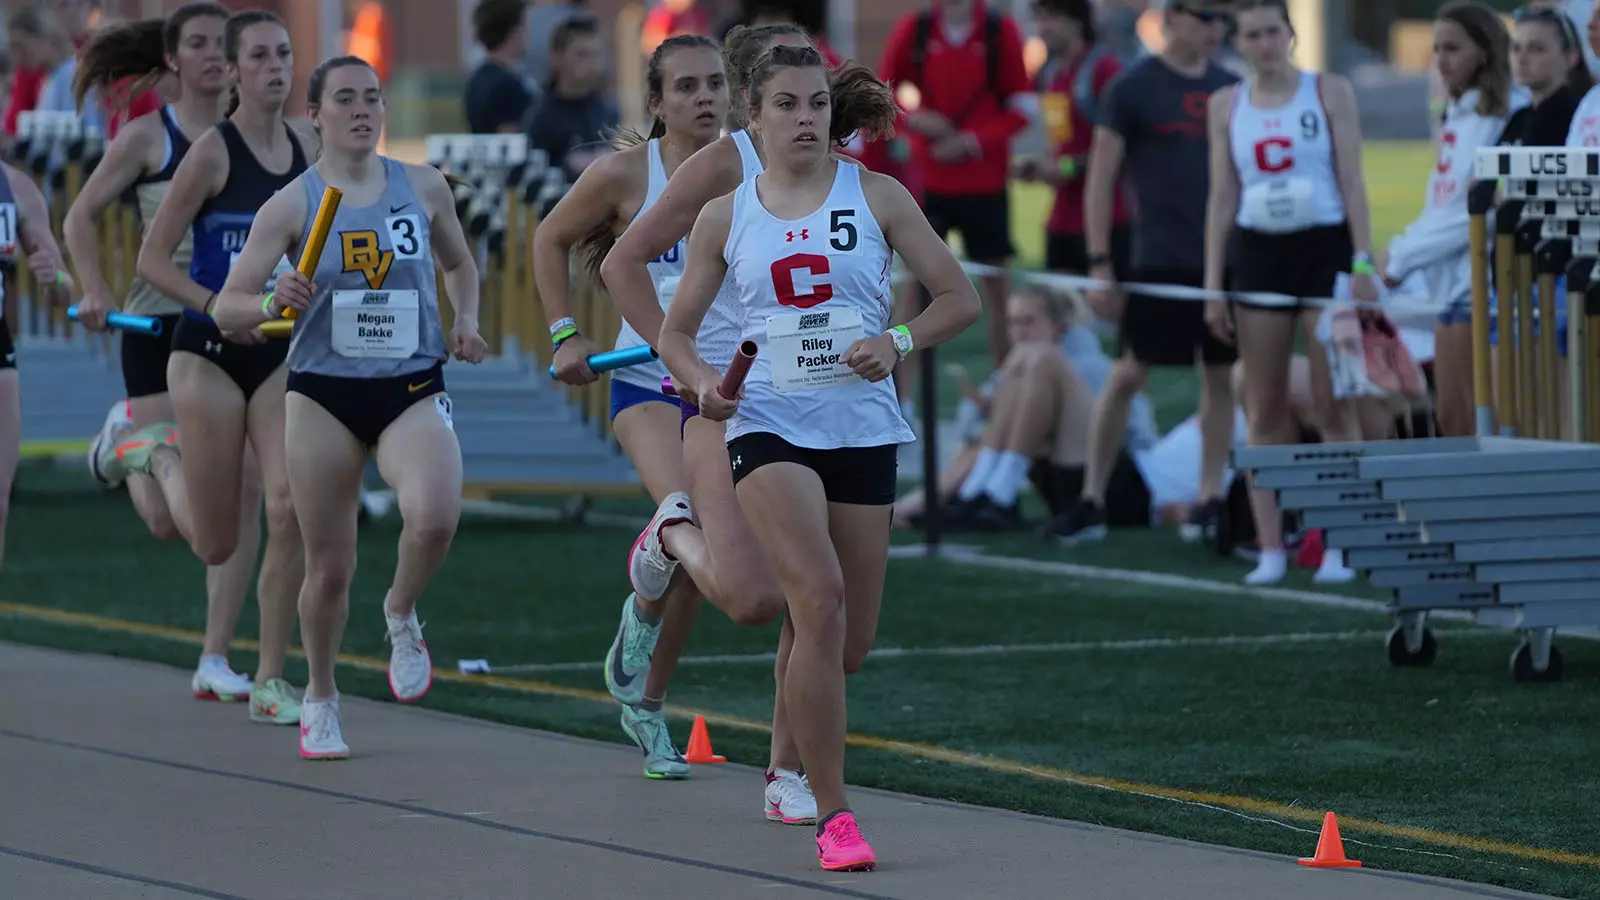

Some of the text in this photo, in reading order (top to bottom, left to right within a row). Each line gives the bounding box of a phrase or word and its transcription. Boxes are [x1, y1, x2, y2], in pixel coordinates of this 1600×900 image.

[1300, 110, 1318, 140] 9
[1254, 136, 1294, 173] C
[1529, 153, 1567, 174] UCS
[1556, 179, 1592, 196] UCS
[392, 218, 419, 255] 3
[829, 209, 858, 251] 5
[338, 229, 395, 289] BV
[770, 253, 833, 308] C
[357, 313, 395, 325] Megan
[800, 312, 830, 321] AMERICAN
[358, 326, 393, 338] Bakke
[802, 339, 833, 351] Riley
[797, 353, 841, 368] Packer
